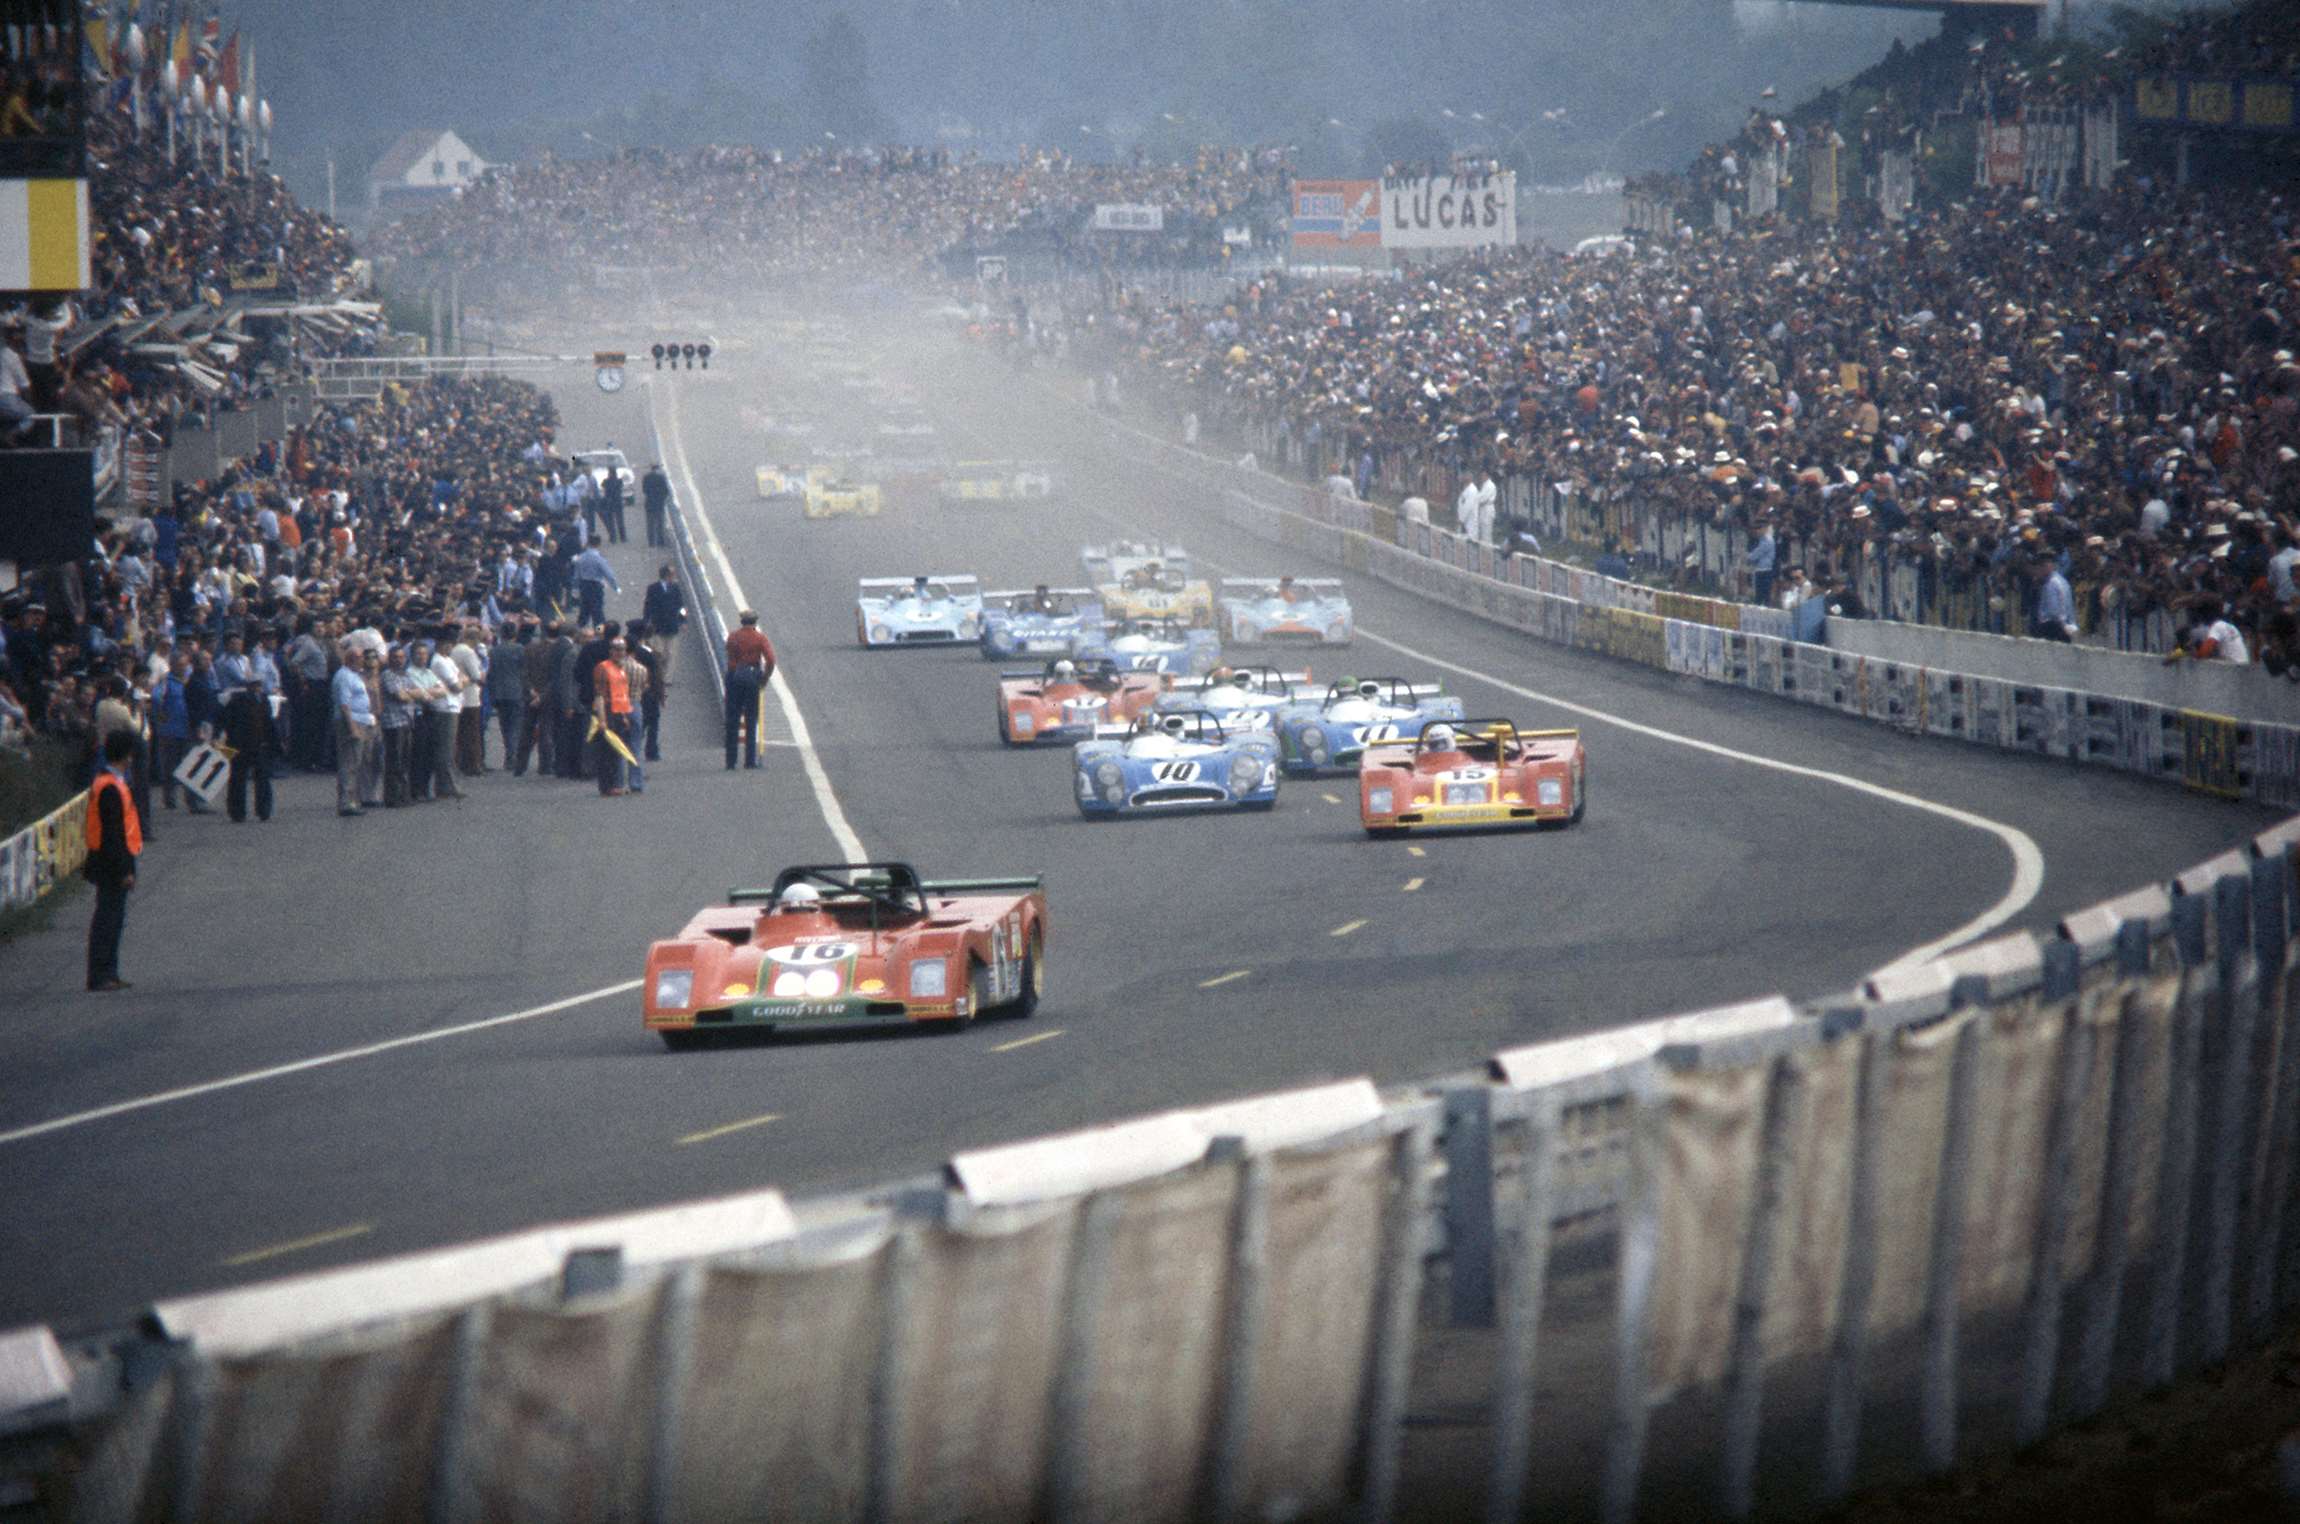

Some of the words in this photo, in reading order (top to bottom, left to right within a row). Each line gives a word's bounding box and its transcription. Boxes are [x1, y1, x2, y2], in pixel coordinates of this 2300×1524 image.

[1394, 193, 1498, 230] LUCAS
[1361, 726, 1392, 744] 11
[186, 749, 225, 790] 11
[1159, 762, 1196, 782] 10
[1451, 768, 1487, 781] 15
[789, 943, 849, 961] 16
[752, 1002, 846, 1017] GOODYEAR
